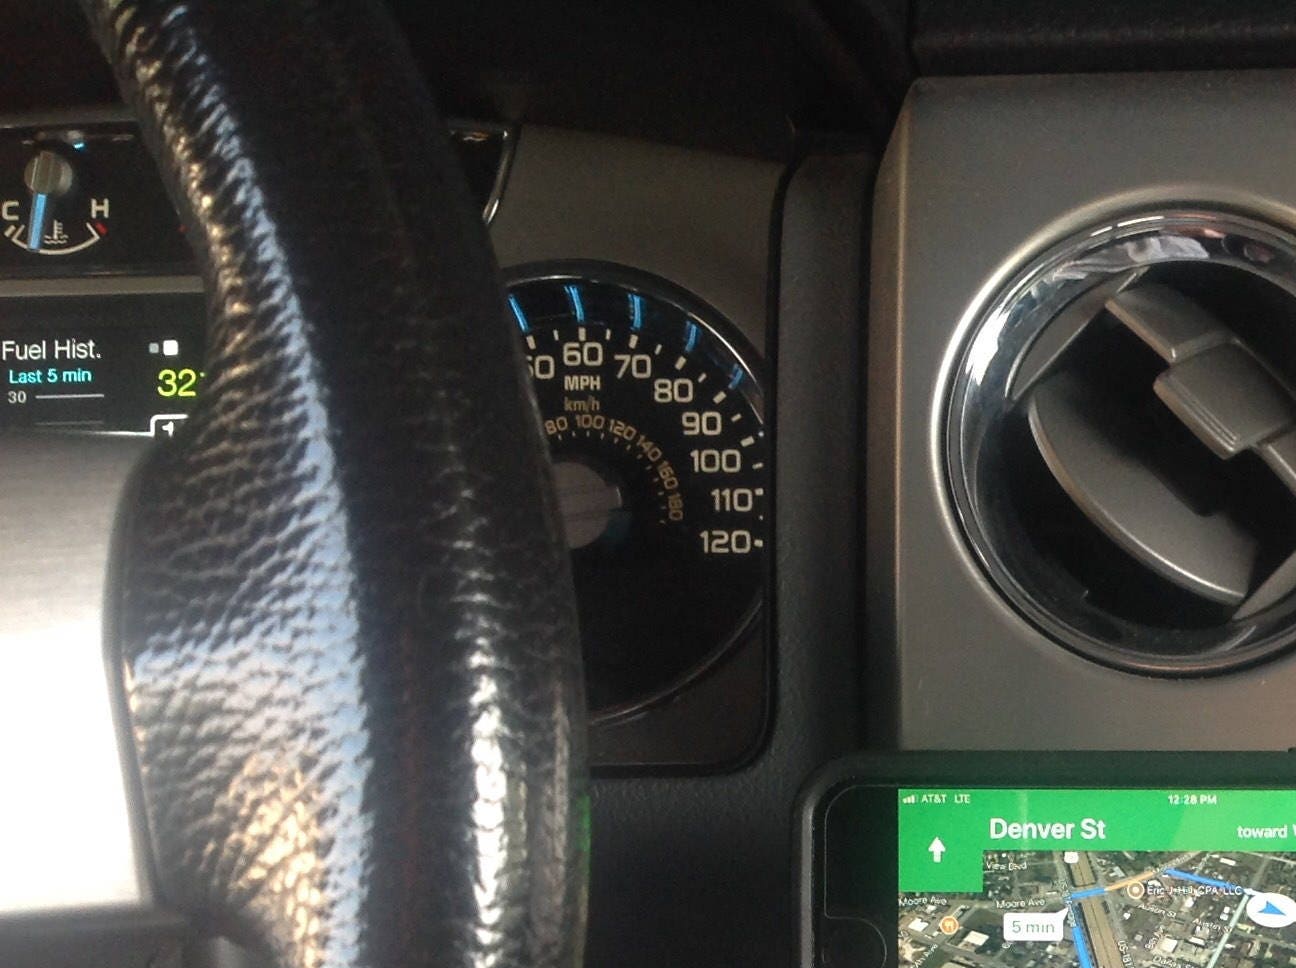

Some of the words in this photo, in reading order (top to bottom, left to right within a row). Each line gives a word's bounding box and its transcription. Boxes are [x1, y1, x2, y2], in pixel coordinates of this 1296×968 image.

[1, 200, 20, 221] C
[90, 198, 109, 219] H
[2, 340, 46, 361] Fuel
[54, 338, 101, 360] Hist.
[563, 342, 603, 366] 60
[8, 369, 42, 384] Last
[47, 368, 58, 383] 5
[62, 368, 92, 382] min
[614, 354, 651, 379] 70
[564, 376, 600, 391] MPH
[654, 379, 693, 403] 80
[7, 391, 27, 404] 30
[564, 397, 600, 411] km/h
[544, 417, 567, 434] 80
[575, 415, 604, 429] 100
[609, 419, 637, 441] 120
[681, 412, 721, 435] 90
[637, 435, 662, 461] 140
[690, 449, 742, 472] 100
[658, 461, 679, 489] 160
[668, 493, 683, 520] 180
[711, 488, 752, 512] 110
[700, 530, 750, 553] 120
[921, 794, 946, 804] AT&T
[954, 794, 971, 804] LTE
[990, 818, 1075, 840] Denver
[1081, 818, 1106, 840] St
[1237, 824, 1288, 839] toward
[1011, 920, 1022, 933] 5
[1025, 922, 1055, 933] min
